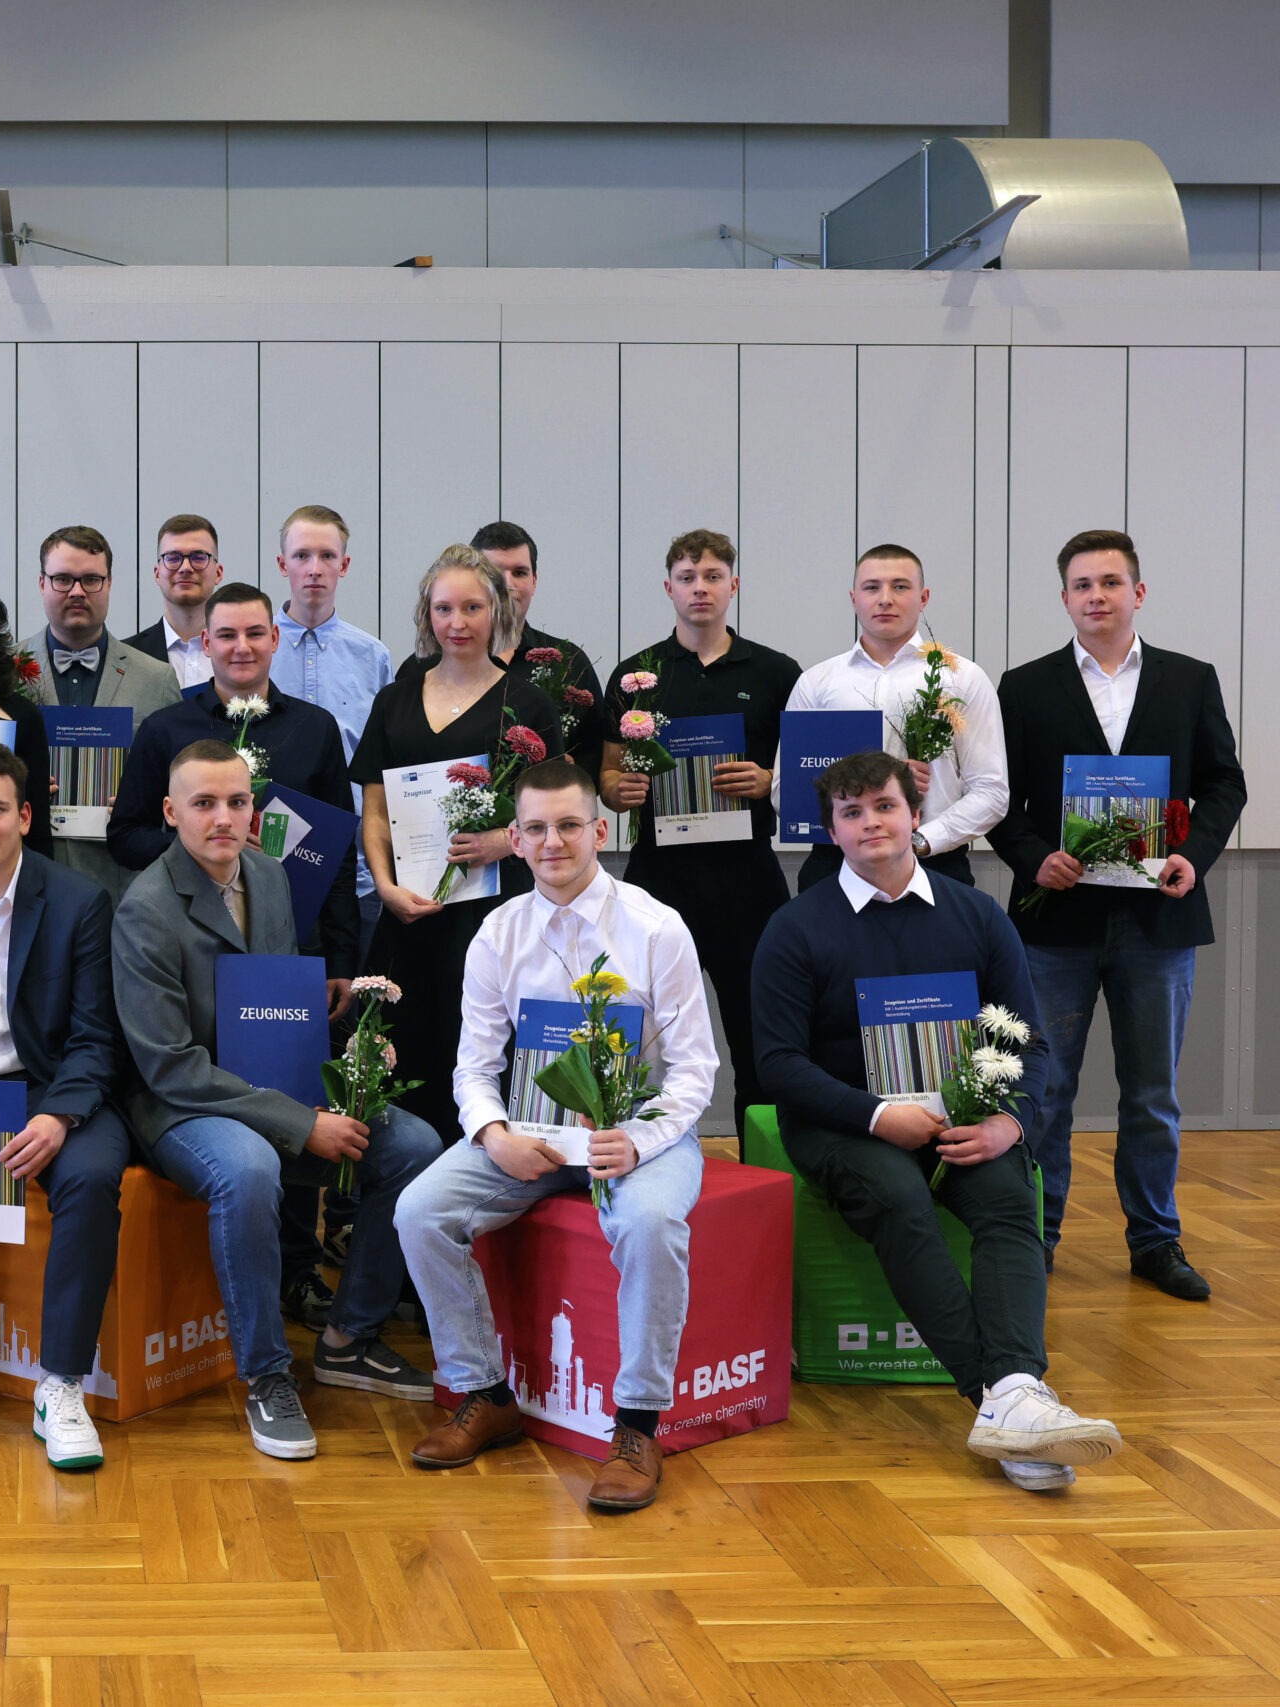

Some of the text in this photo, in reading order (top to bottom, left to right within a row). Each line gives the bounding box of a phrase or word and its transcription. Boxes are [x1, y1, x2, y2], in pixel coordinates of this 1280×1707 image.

[403, 788, 433, 798] Zeugnisse
[239, 1007, 310, 1021] ZEUGNISSE
[182, 1308, 230, 1353] BAS
[145, 1349, 234, 1391] We create chemis
[693, 1349, 766, 1400] BASF
[838, 1359, 864, 1371] We
[868, 1358, 918, 1370] create
[673, 1412, 713, 1432] create
[715, 1394, 767, 1422] chemistry
